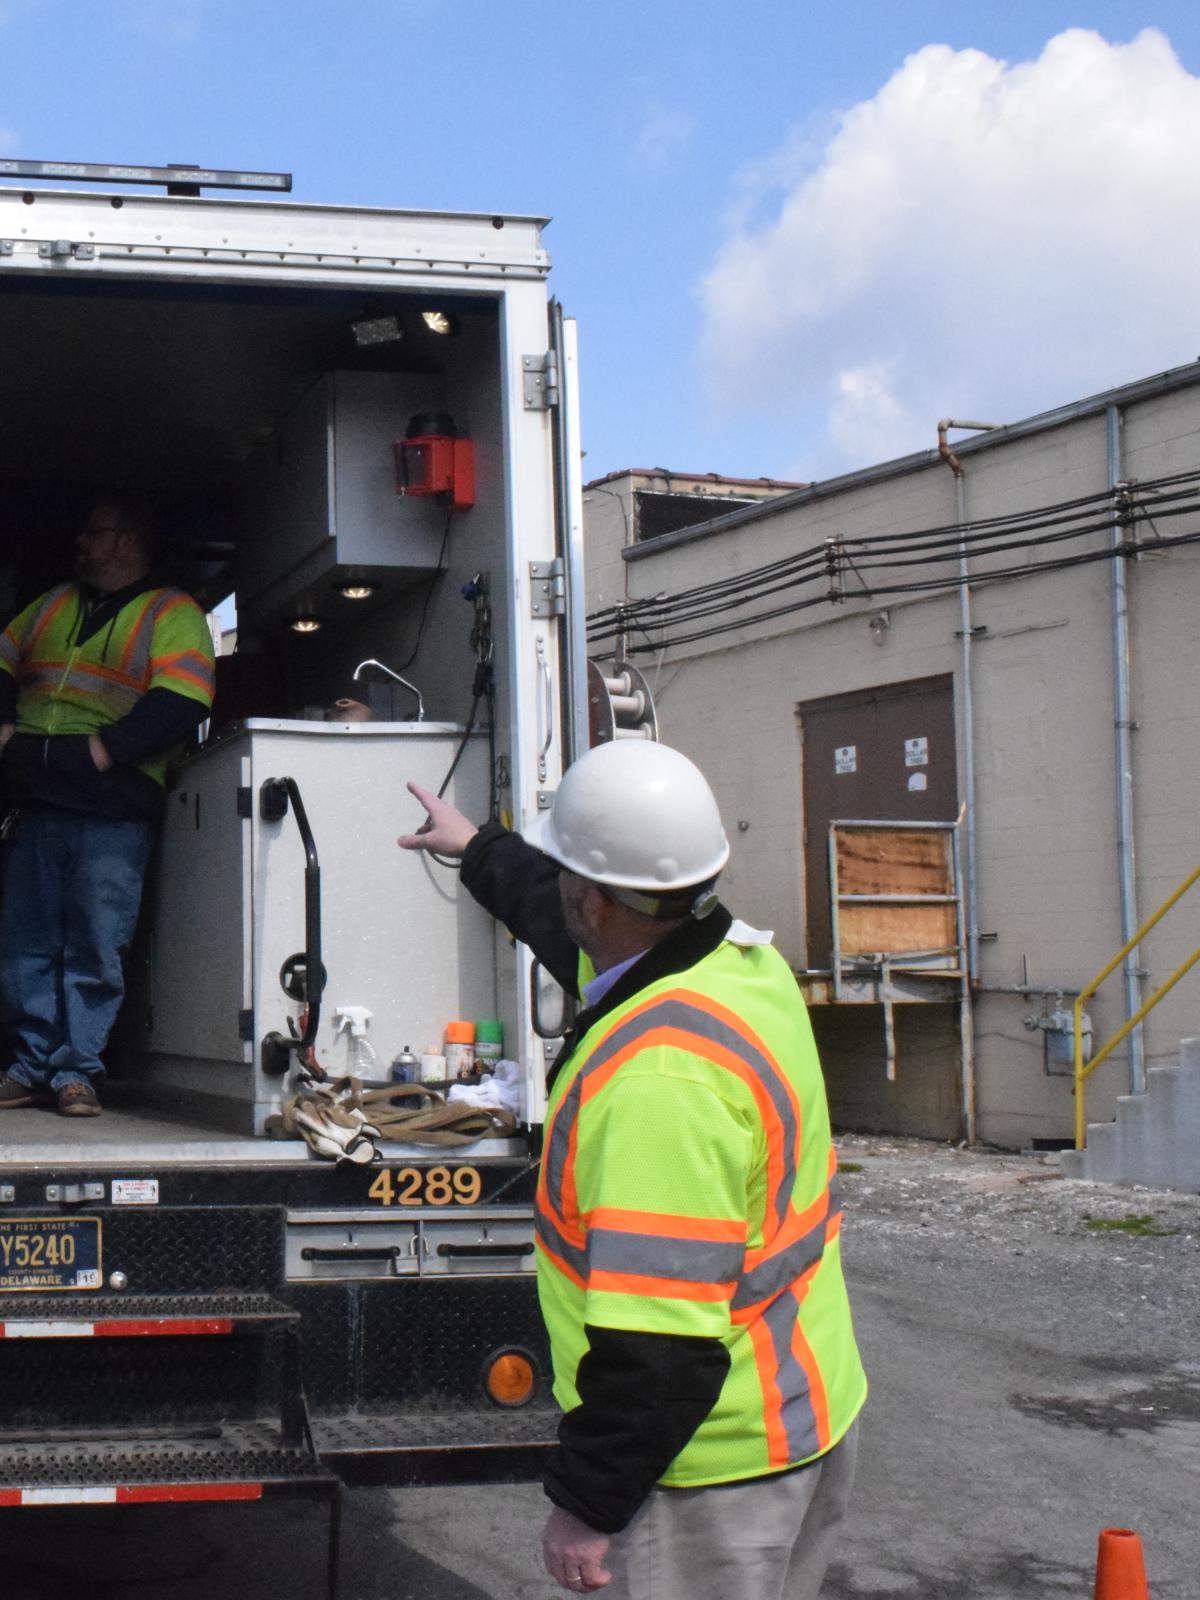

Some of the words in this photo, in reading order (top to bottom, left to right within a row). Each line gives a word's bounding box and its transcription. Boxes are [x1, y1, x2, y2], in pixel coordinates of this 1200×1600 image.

[368, 1167, 482, 1206] 4289
[16, 1222, 37, 1231] FIRST
[42, 1222, 66, 1231] STATE
[0, 1275, 62, 1286] DELAWARE
